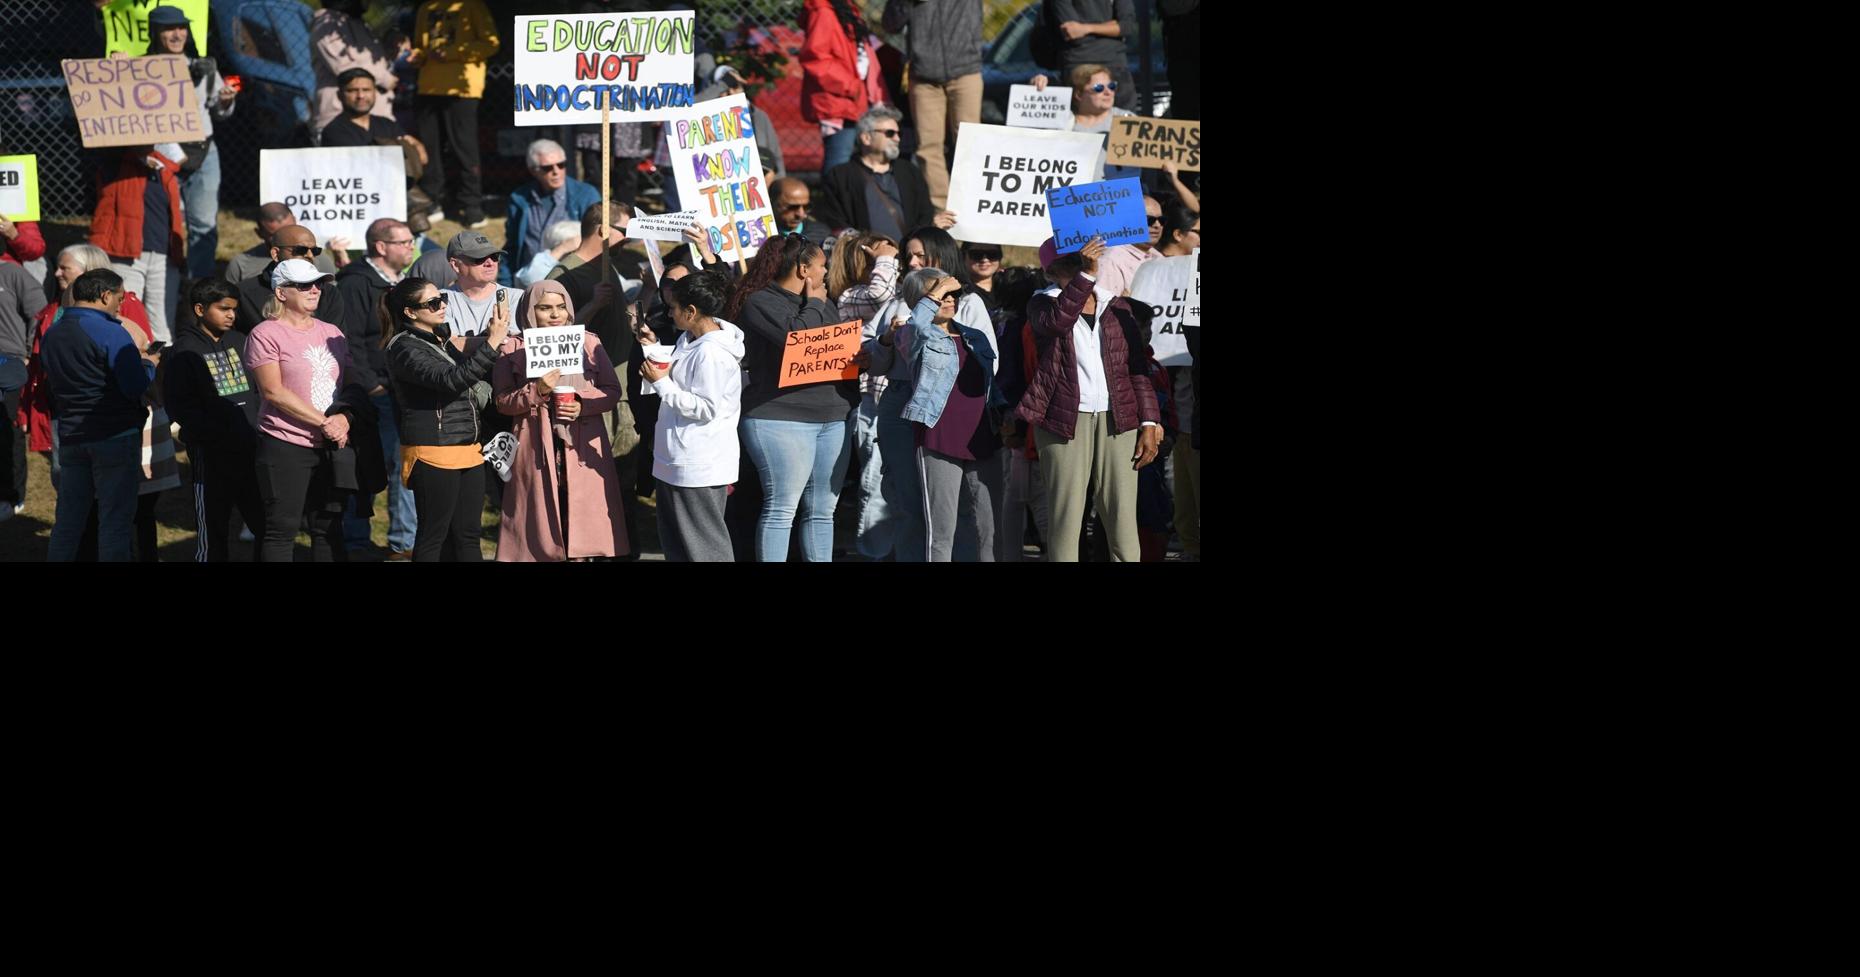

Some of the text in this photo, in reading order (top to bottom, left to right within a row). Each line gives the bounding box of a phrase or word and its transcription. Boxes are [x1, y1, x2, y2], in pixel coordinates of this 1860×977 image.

[110, 9, 149, 42] NE
[527, 16, 695, 55] EDUCATION
[64, 58, 180, 86] RESPECT
[575, 52, 645, 81] NOT
[72, 79, 193, 111] DO NOT
[514, 82, 695, 112] INDOCTRINATION
[80, 112, 199, 138] INTERFERE
[676, 106, 754, 149] PARENTS
[1119, 120, 1200, 149] TRANS
[692, 146, 750, 183] KNOW
[984, 155, 1078, 174] I BELONG
[1131, 141, 1200, 167] RIGHTS
[0, 170, 19, 186] ED
[302, 178, 363, 190] LEAVE
[982, 171, 1022, 193] TO
[284, 193, 380, 206] OUR KIDS
[699, 176, 765, 217] THEIR
[977, 199, 1046, 217] PAREN
[1048, 184, 1130, 208] Education
[300, 209, 365, 221] ALONE
[1083, 202, 1117, 218] NOT
[736, 214, 774, 248] BEST
[528, 333, 581, 345] I BELONG
[787, 322, 859, 346] Schools Don't
[529, 342, 579, 357] TO MY
[804, 343, 844, 359] Replace
[530, 357, 579, 369] PARENTS
[789, 357, 848, 377] PARENTS
